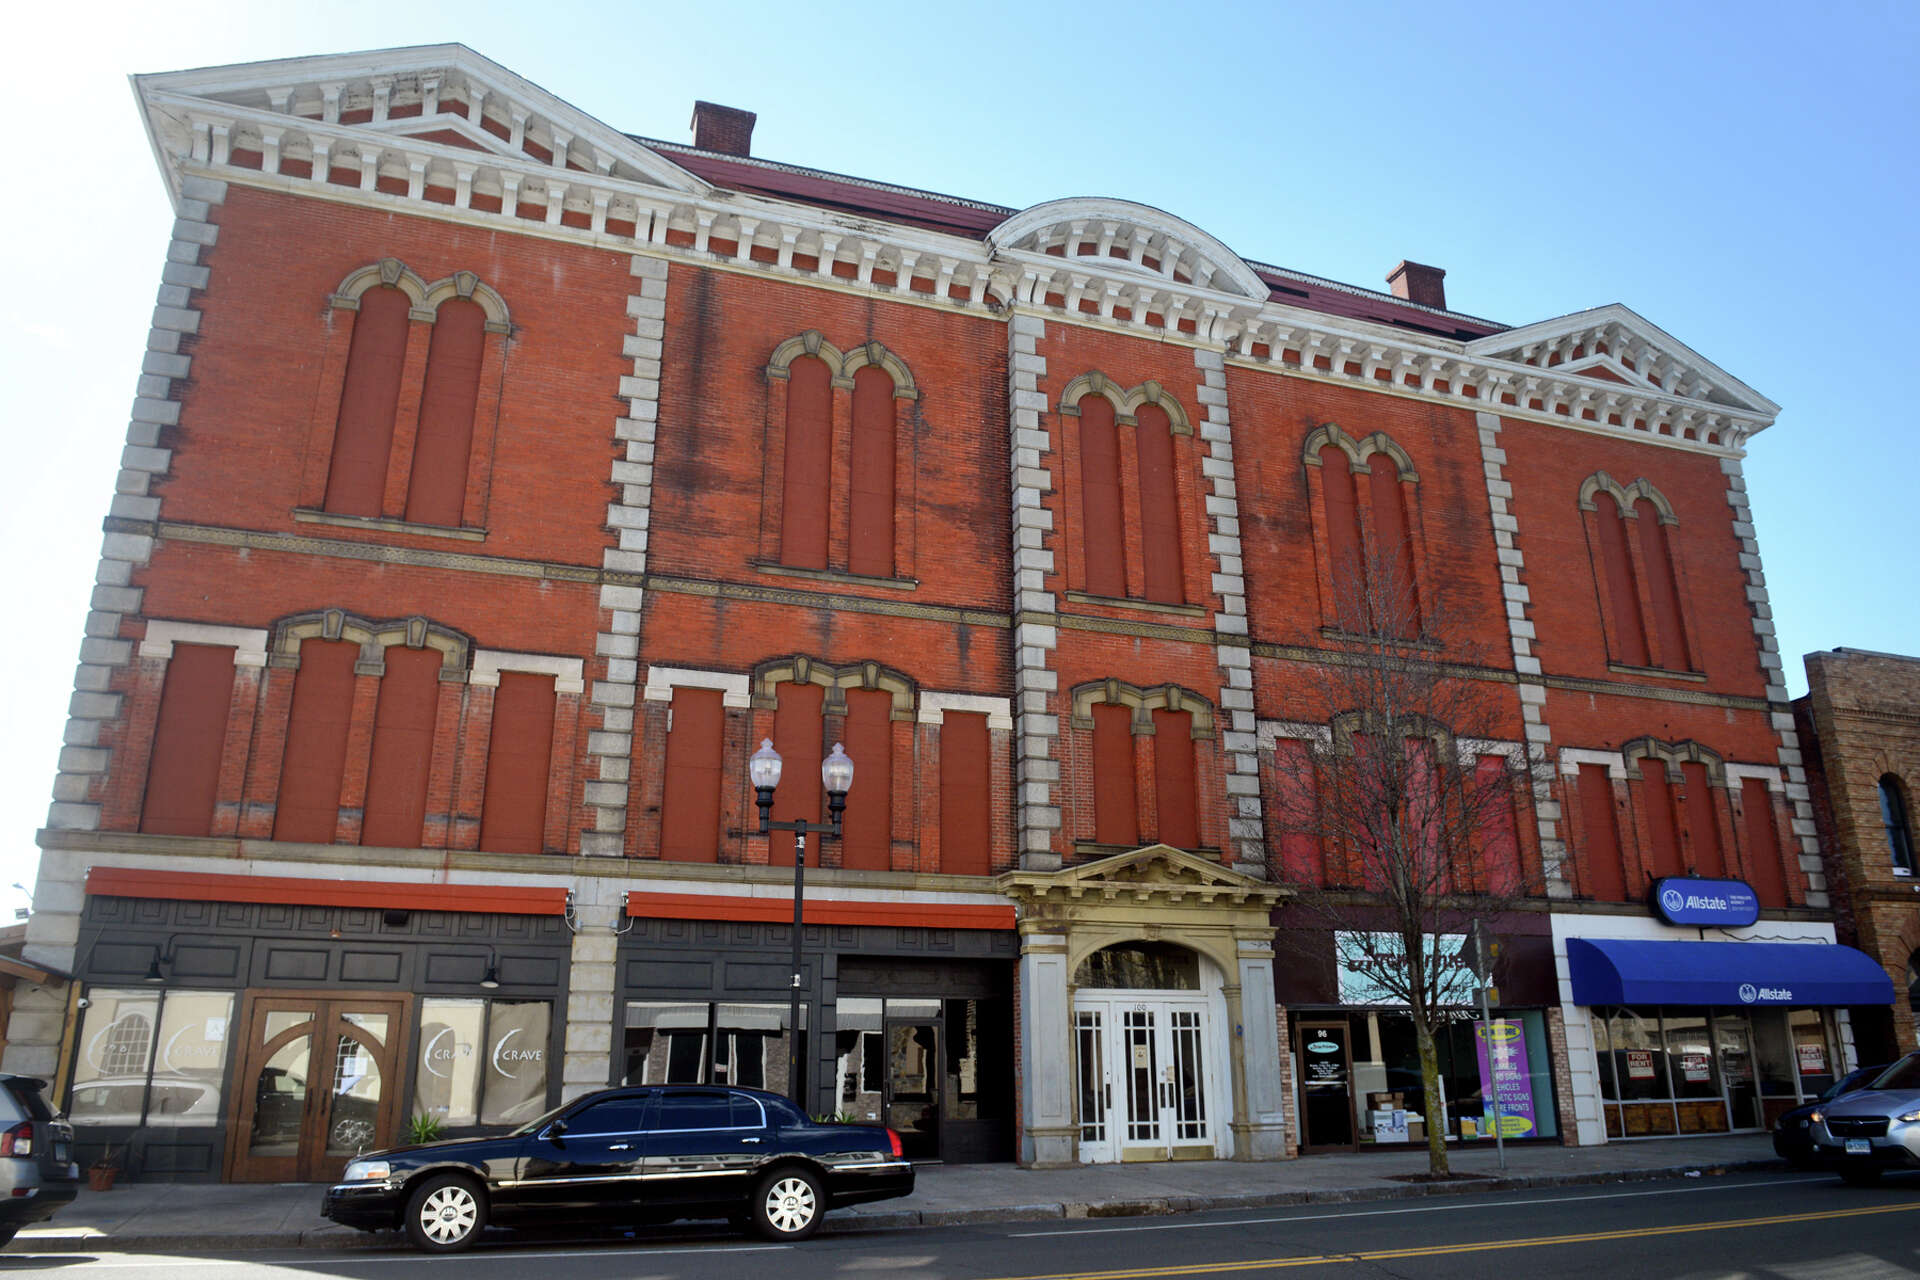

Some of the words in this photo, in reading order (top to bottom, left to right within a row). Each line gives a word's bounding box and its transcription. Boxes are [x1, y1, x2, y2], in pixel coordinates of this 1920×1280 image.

[1685, 896, 1727, 910] Allstate
[1758, 988, 1792, 1000] Allstate
[1134, 1003, 1146, 1011] 100
[1317, 1030, 1328, 1038] 96
[502, 1049, 542, 1060] CRAVE
